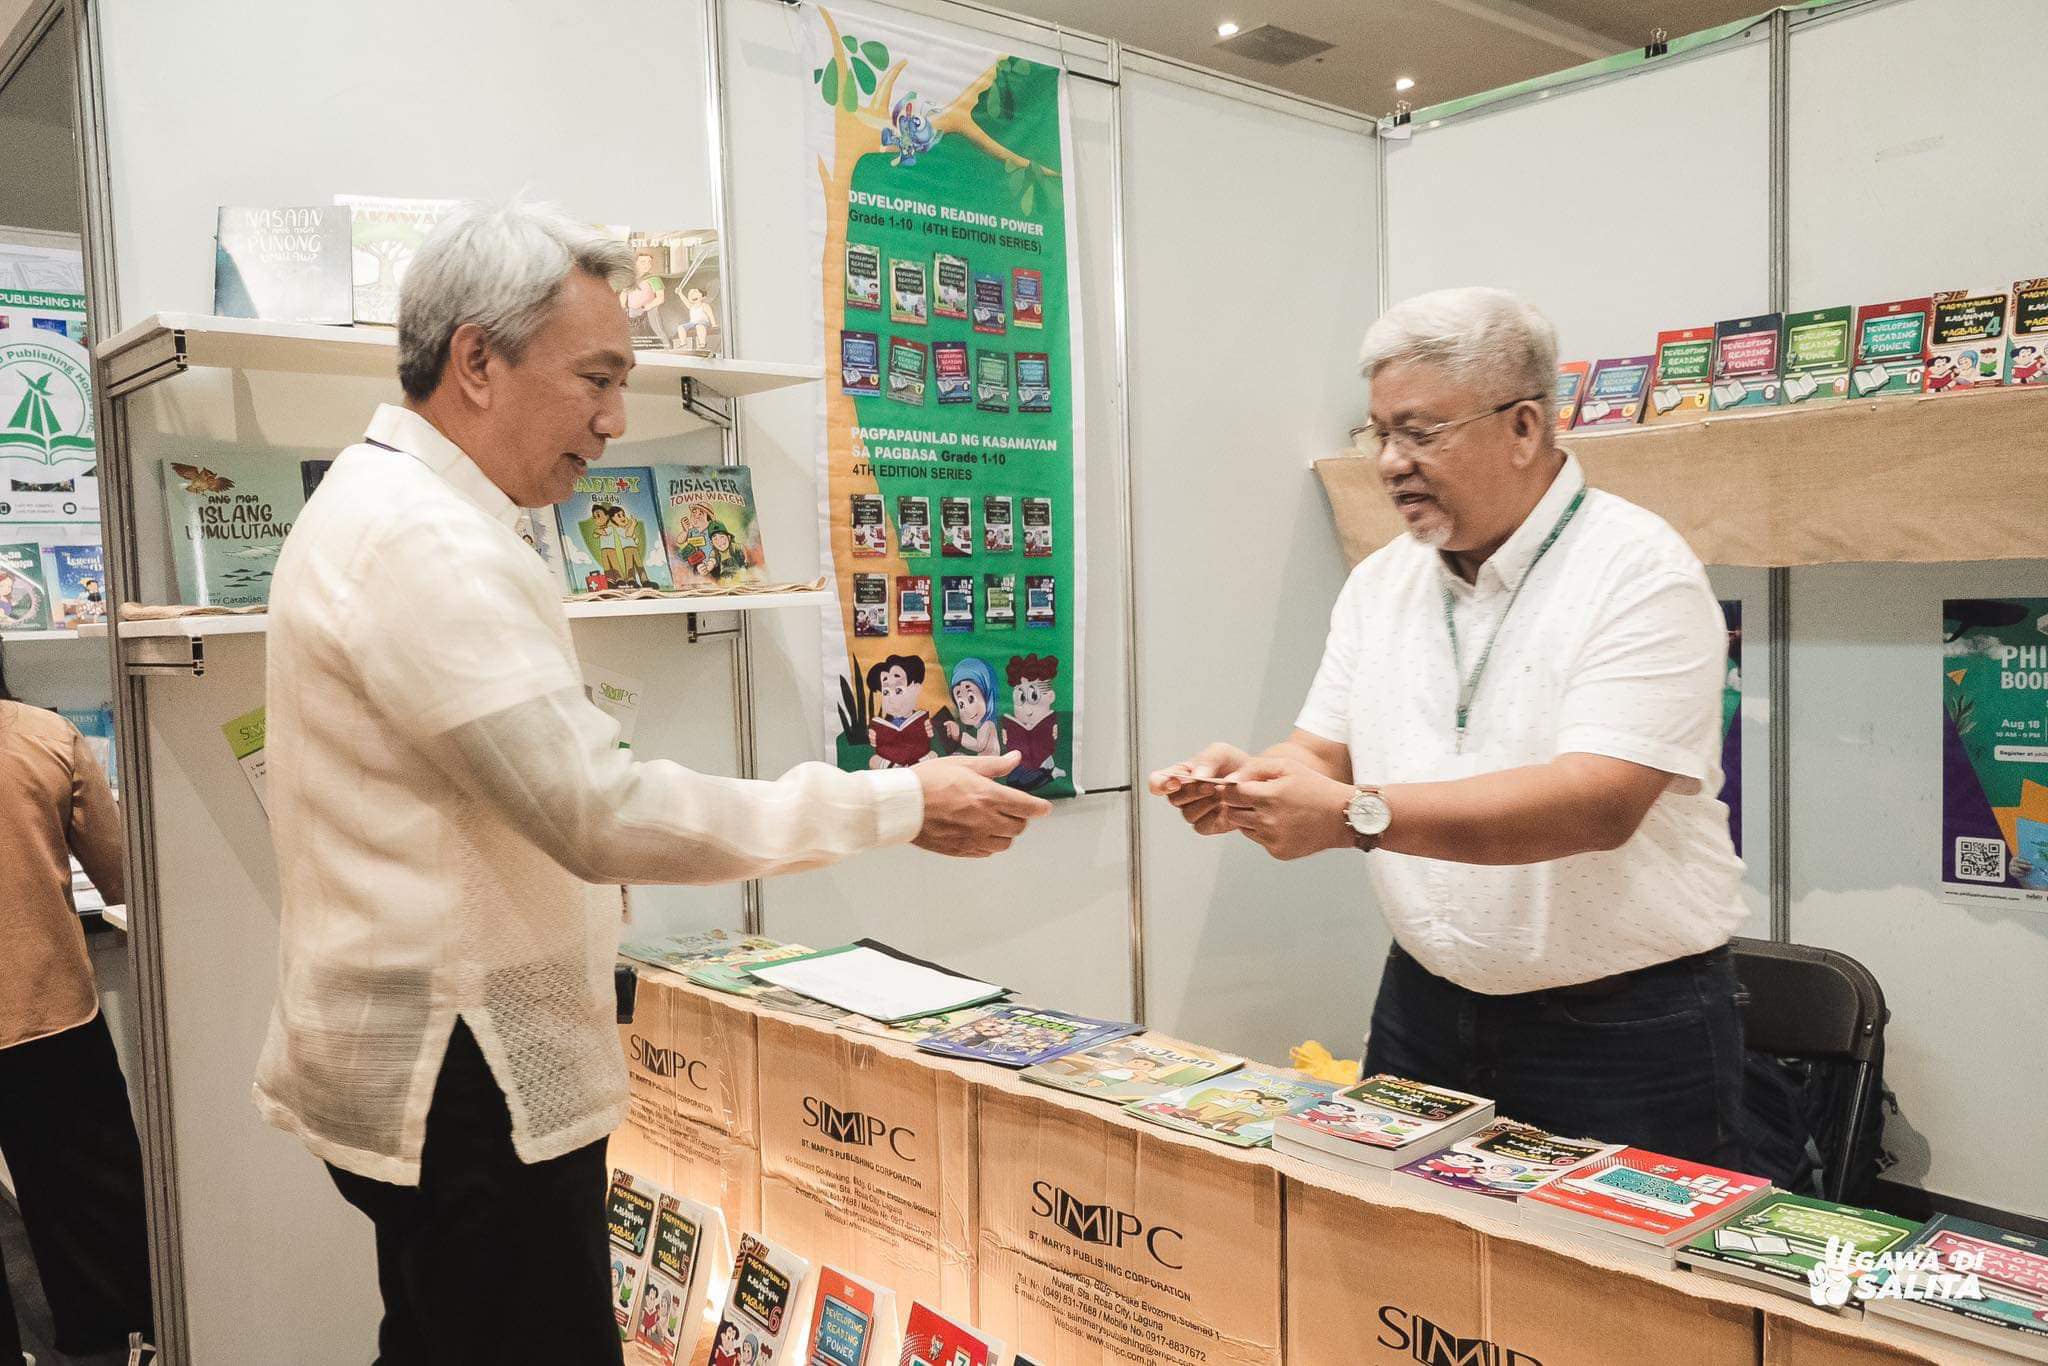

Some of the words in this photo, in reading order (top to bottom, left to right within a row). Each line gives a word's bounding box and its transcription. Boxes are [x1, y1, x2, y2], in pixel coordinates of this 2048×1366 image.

[245, 208, 324, 228] NASAAN
[848, 190, 937, 217] DEVELOPING
[940, 206, 998, 228] READING
[1000, 217, 1044, 236] POWER
[247, 234, 321, 254] PUNONG
[849, 209, 885, 226] Grade
[889, 215, 913, 231] 1-10
[923, 222, 948, 237] (4TH
[952, 227, 996, 246] EDITION
[999, 235, 1042, 255] SERIES)
[0, 293, 70, 308] PUBLISHING
[1866, 319, 1920, 333] DEVELOPING
[1871, 330, 1918, 343] READING
[1984, 315, 2001, 336] 4
[1871, 342, 1911, 352] POWER
[8, 349, 75, 375] Publishing
[1728, 360, 1765, 369] POWER
[1906, 369, 1922, 384] 10
[851, 427, 957, 445] PAGPAPAUNLAD
[961, 434, 979, 447] NG
[982, 435, 1057, 451] KASANAYAN
[852, 446, 870, 458] SA
[875, 446, 938, 462] PAGBASA
[941, 451, 978, 463] Grade
[981, 453, 1006, 465] 1-10
[852, 464, 876, 477] 4TH
[880, 464, 927, 478] EDITION
[931, 467, 972, 480] SERIES
[575, 476, 640, 493] AFETY
[669, 478, 740, 494] DISASTER
[670, 494, 702, 506] TOWN
[704, 494, 746, 506] WATCH
[199, 504, 273, 524] ISLANG
[2001, 720, 2025, 730] Aug
[630, 1033, 708, 1091] SMPC
[802, 1096, 916, 1162] SMPC
[835, 1150, 875, 1171] PUBLISHING
[875, 1163, 922, 1189] CORPORATION
[1031, 1180, 1184, 1270] SMPC
[634, 1226, 647, 1253] 4
[679, 1254, 690, 1282] 5
[1041, 1235, 1071, 1255] MARY'S
[1072, 1248, 1123, 1277] PUBLISHING
[1124, 1269, 1191, 1302] CORPORATION
[768, 1305, 783, 1332] 6
[825, 1307, 863, 1334] DEVELOPING
[1042, 1284, 1062, 1303] (049)
[1103, 1311, 1128, 1331] Mobile
[1130, 1324, 1144, 1338] No.
[1093, 1295, 1113, 1311] Rosa
[1114, 1303, 1131, 1321] City,
[1133, 1311, 1163, 1331] Laguna
[827, 1320, 859, 1347] READING
[826, 1336, 855, 1362] POWER
